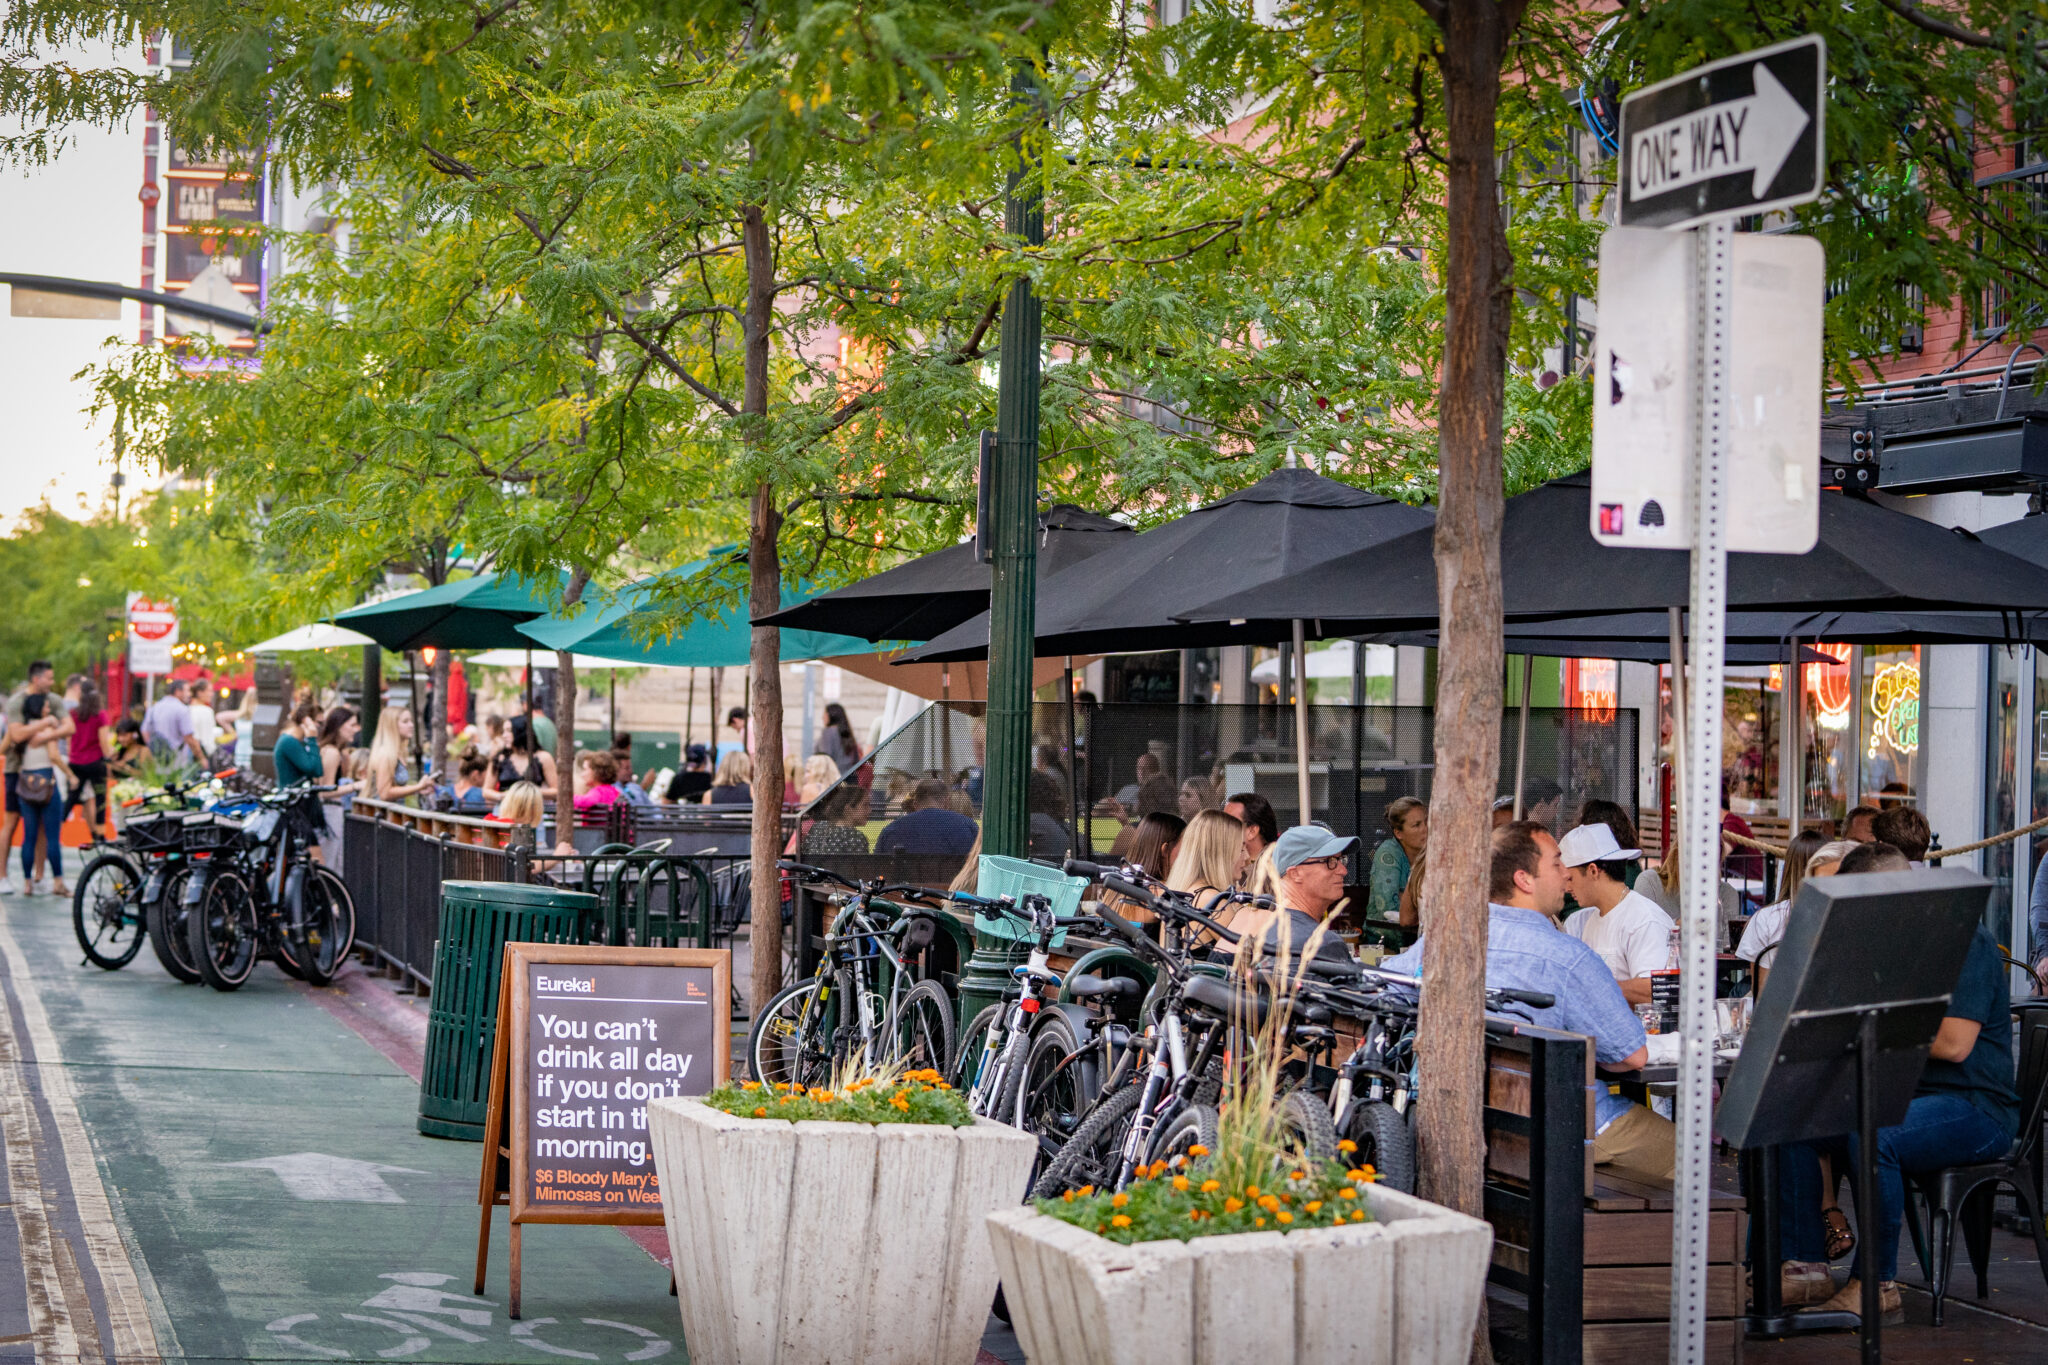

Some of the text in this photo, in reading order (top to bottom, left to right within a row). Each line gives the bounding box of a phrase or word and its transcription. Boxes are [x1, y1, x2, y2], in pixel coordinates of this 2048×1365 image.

[1637, 105, 1749, 190] ONE WAY
[536, 975, 596, 993] Eureka!
[537, 1013, 658, 1041] You can’t
[537, 1044, 693, 1078] drink all day
[537, 1073, 681, 1104] if you don’t
[536, 1105, 648, 1130] start in th
[536, 1135, 653, 1166] morning.
[535, 1168, 659, 1189] $6 Bloody Mary’s
[535, 1186, 602, 1201] Mimosas
[605, 1191, 624, 1203] on
